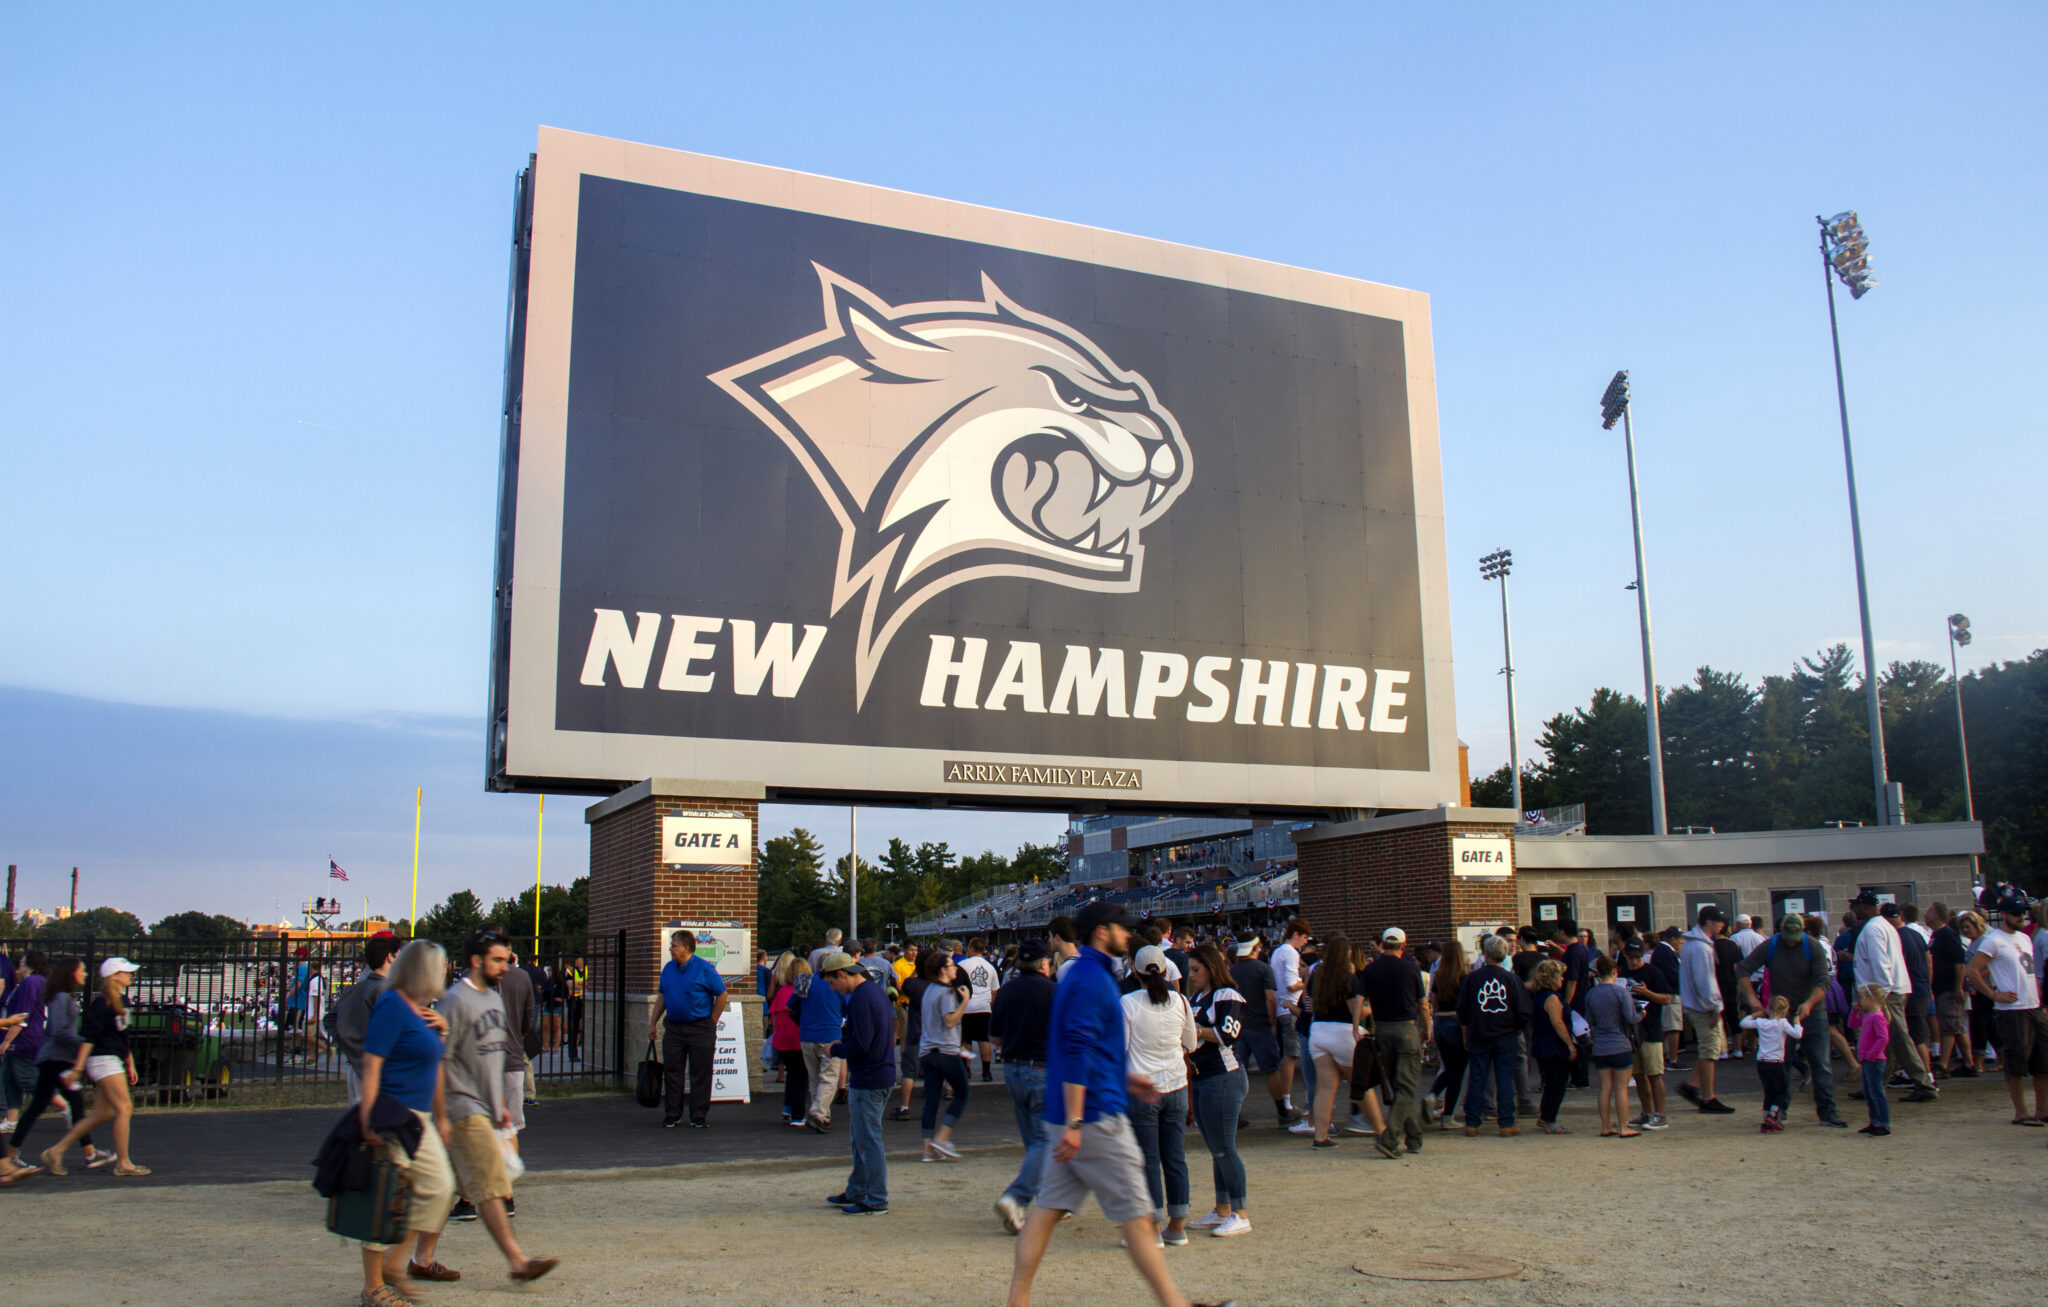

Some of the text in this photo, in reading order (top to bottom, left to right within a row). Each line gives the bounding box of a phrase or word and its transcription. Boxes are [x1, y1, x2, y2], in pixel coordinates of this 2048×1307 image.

[580, 608, 1411, 733] NEW HAMPSHIRE
[947, 764, 1141, 788] ARRIX FAMILY PLAZA
[674, 832, 739, 849] GATE A
[1461, 850, 1504, 863] GATE A
[1221, 1015, 1242, 1039] 69
[718, 1046, 737, 1054] Cart
[711, 1067, 738, 1075] cation
